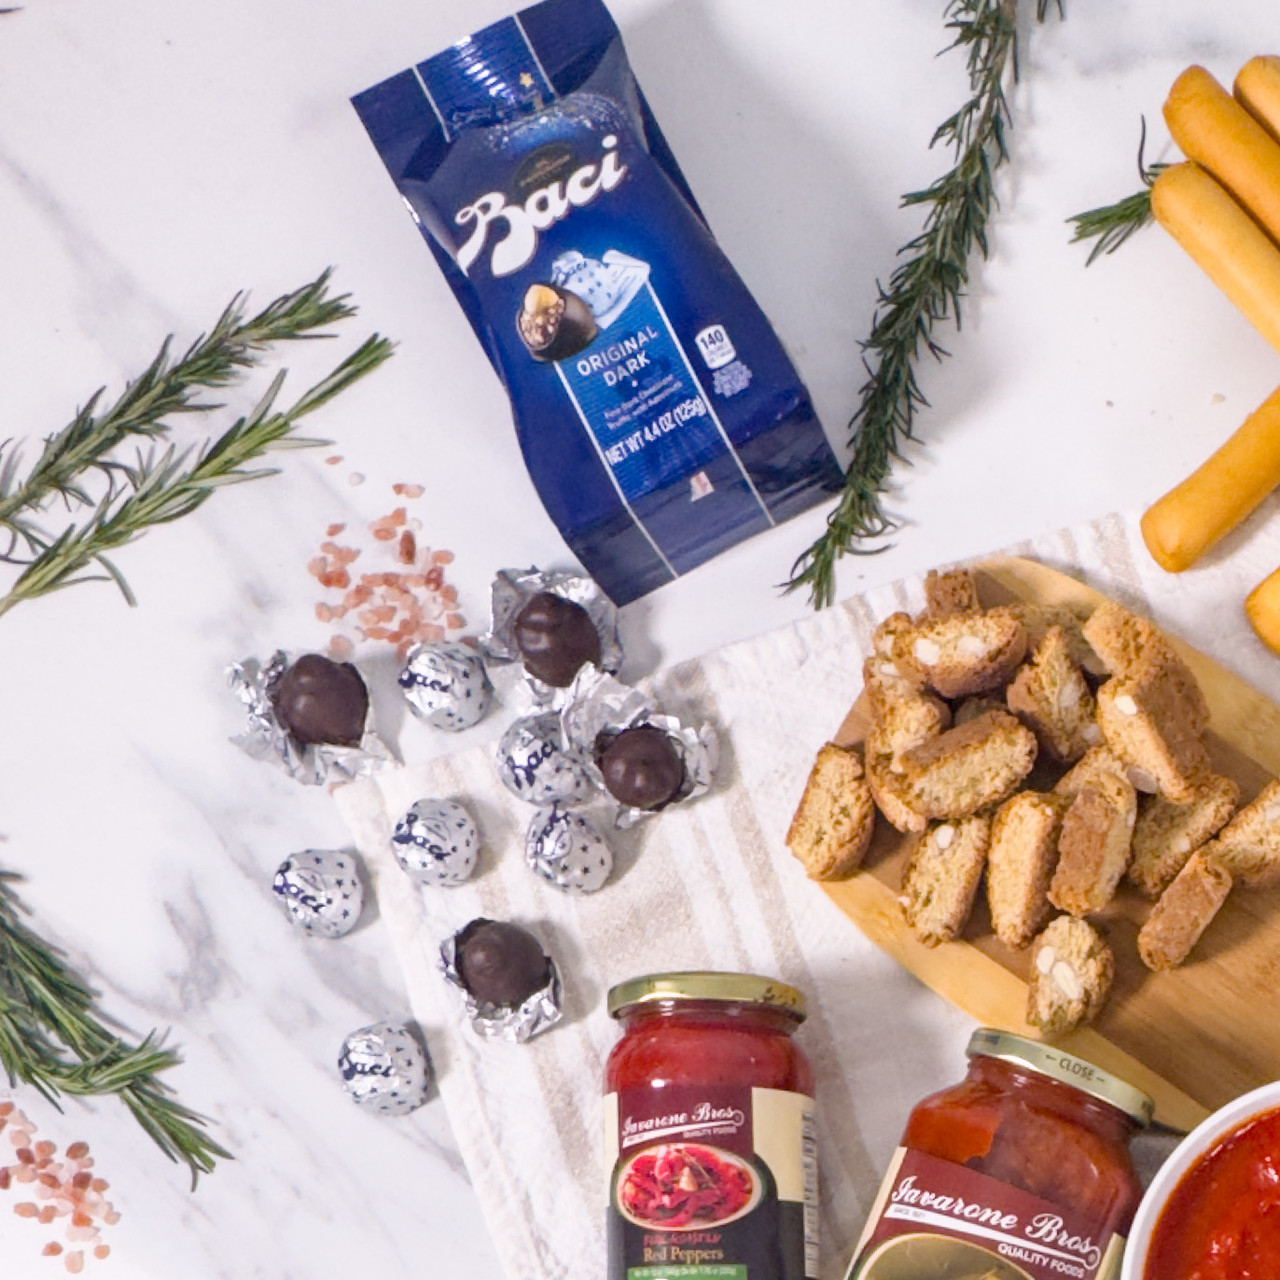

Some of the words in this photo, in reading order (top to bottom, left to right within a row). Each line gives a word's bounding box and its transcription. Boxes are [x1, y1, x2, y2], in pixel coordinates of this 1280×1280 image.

[455, 134, 628, 278] Baci
[577, 325, 658, 377] ORIGINAL
[700, 329, 724, 351] 140
[602, 350, 651, 387] DARK
[605, 441, 629, 466] NET
[624, 431, 646, 454] WT
[659, 411, 677, 433] OZ
[1058, 1057, 1095, 1081] CLOSE
[643, 1247, 667, 1262] Red
[670, 1245, 725, 1265] Peppers
[998, 1243, 1050, 1268] QUALITY
[1049, 1258, 1085, 1279] FOODS
